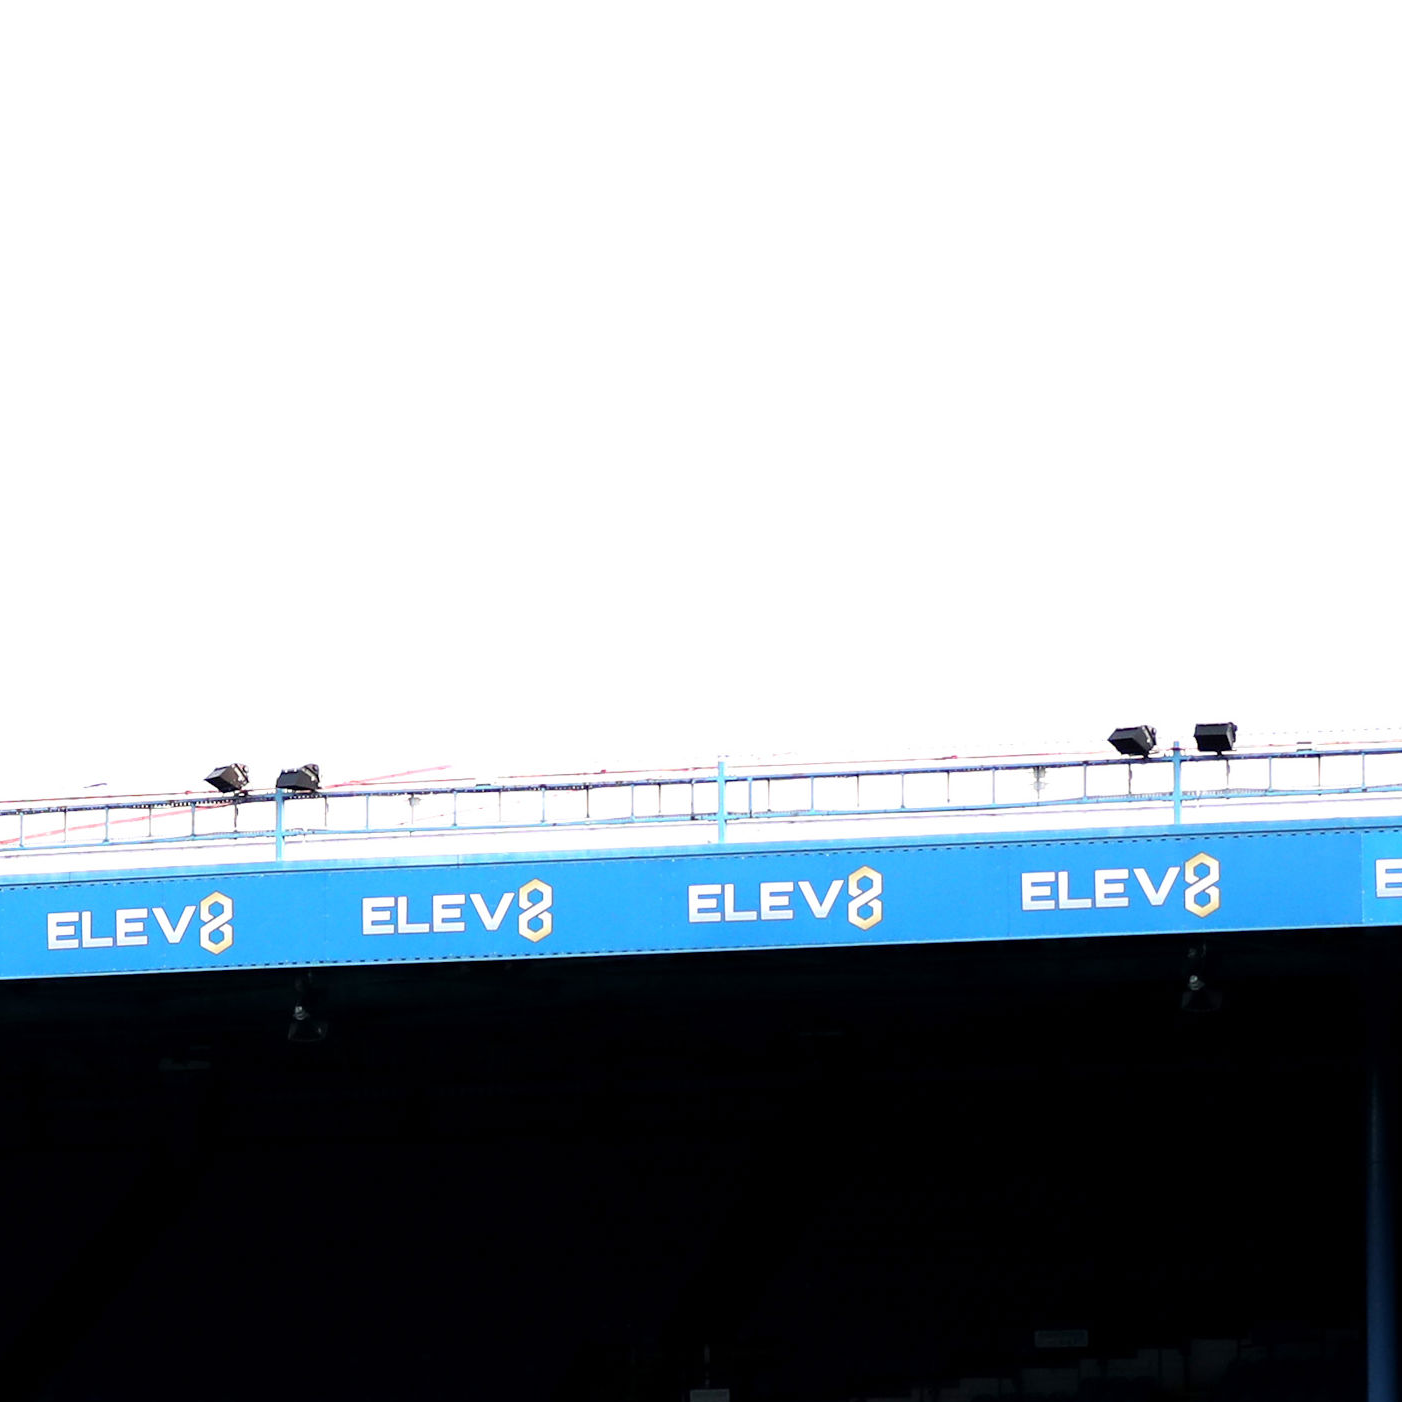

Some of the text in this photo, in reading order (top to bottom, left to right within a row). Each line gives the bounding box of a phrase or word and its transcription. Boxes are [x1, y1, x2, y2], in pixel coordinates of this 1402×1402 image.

[363, 879, 552, 942] ELEV8
[688, 866, 882, 930] ELEV8
[1022, 853, 1220, 917] ELEV8
[48, 892, 233, 954] ELEV8
